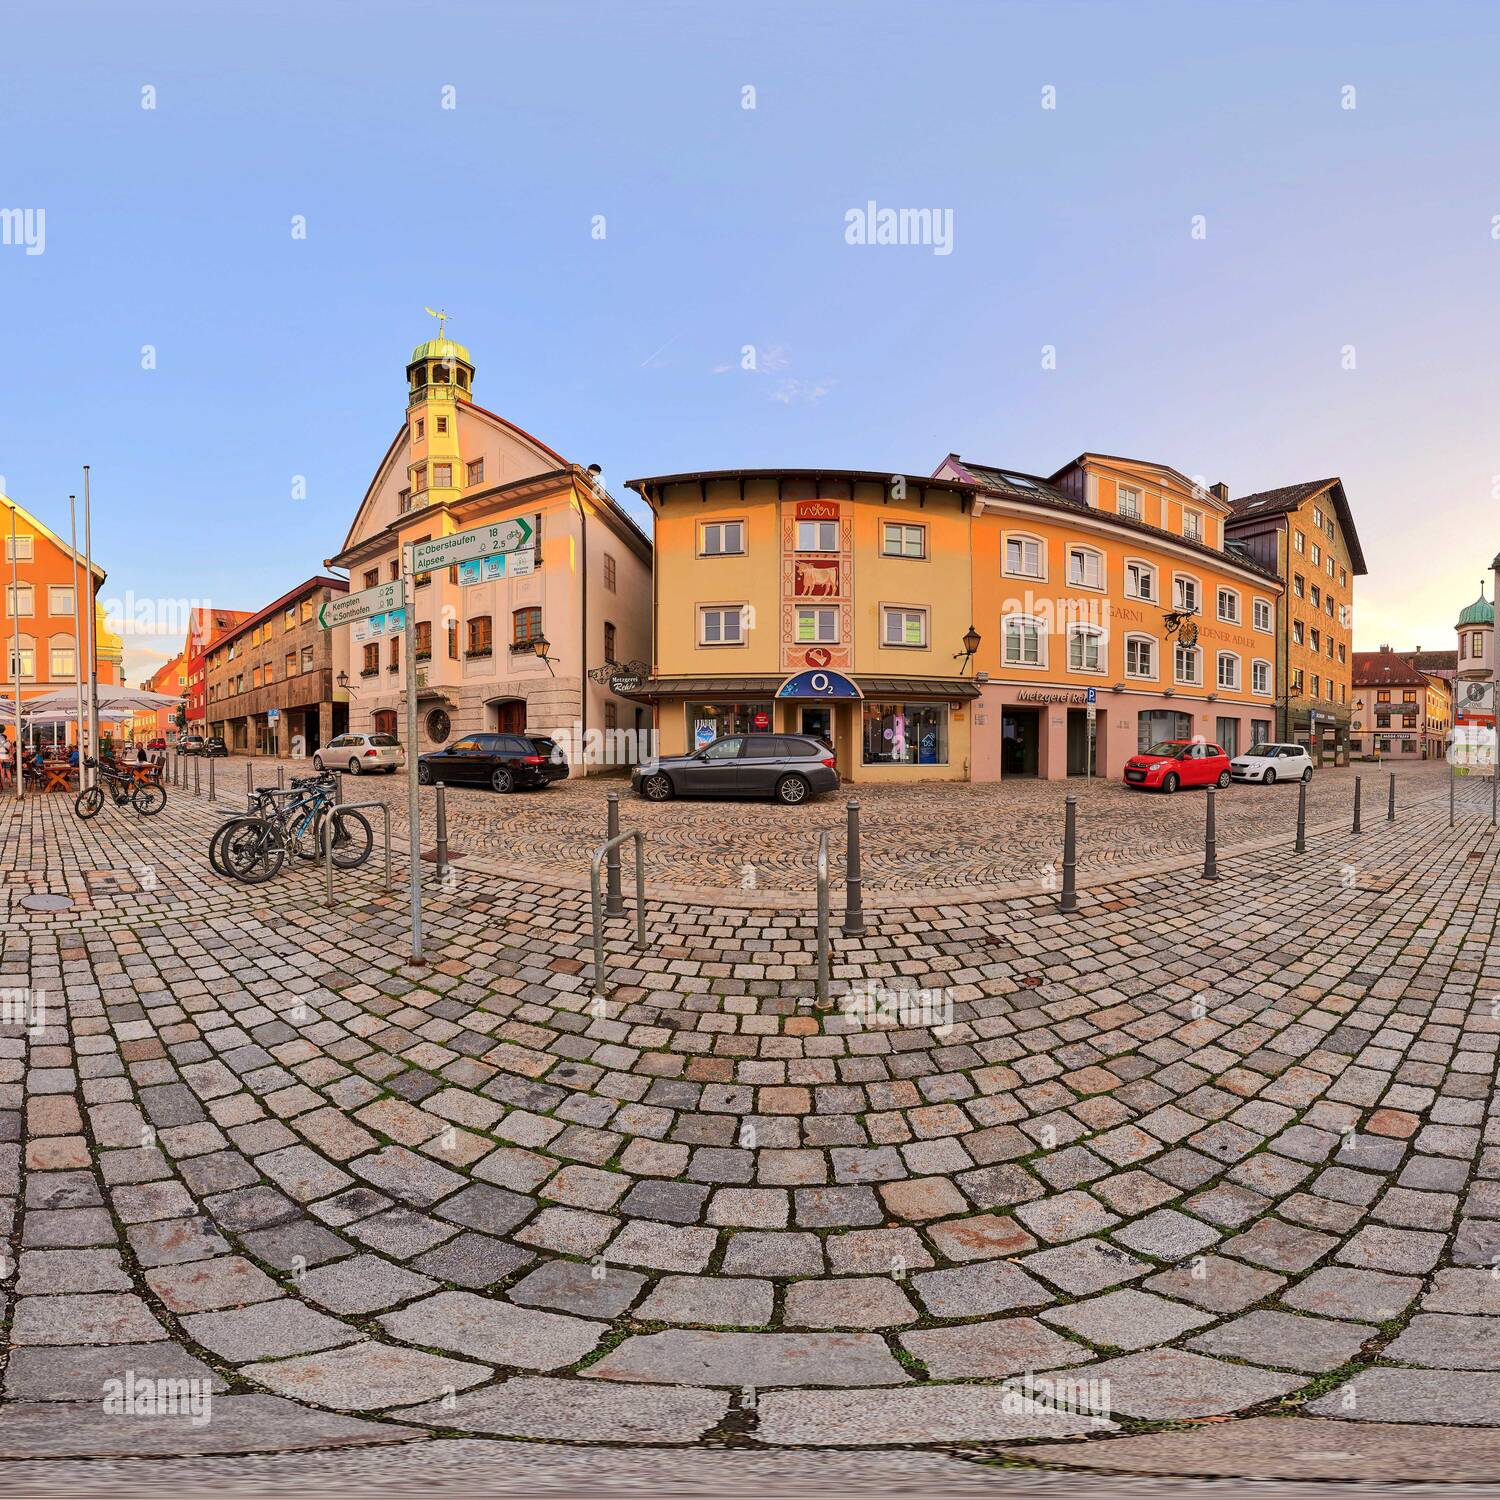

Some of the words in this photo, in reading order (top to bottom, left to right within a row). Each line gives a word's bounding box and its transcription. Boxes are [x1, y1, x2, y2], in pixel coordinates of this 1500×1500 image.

[425, 535, 476, 555] Oberstaufen
[489, 528, 498, 538] 18
[417, 555, 445, 569] Alpsee
[332, 597, 360, 611] Kempten
[385, 586, 394, 596] 25
[338, 605, 370, 621] Sonthofen
[386, 598, 394, 607] 10
[1108, 606, 1144, 624] GARNI
[1231, 634, 1256, 650] ADLER
[1018, 689, 1071, 705] Metzgerei
[1088, 689, 1095, 698] P
